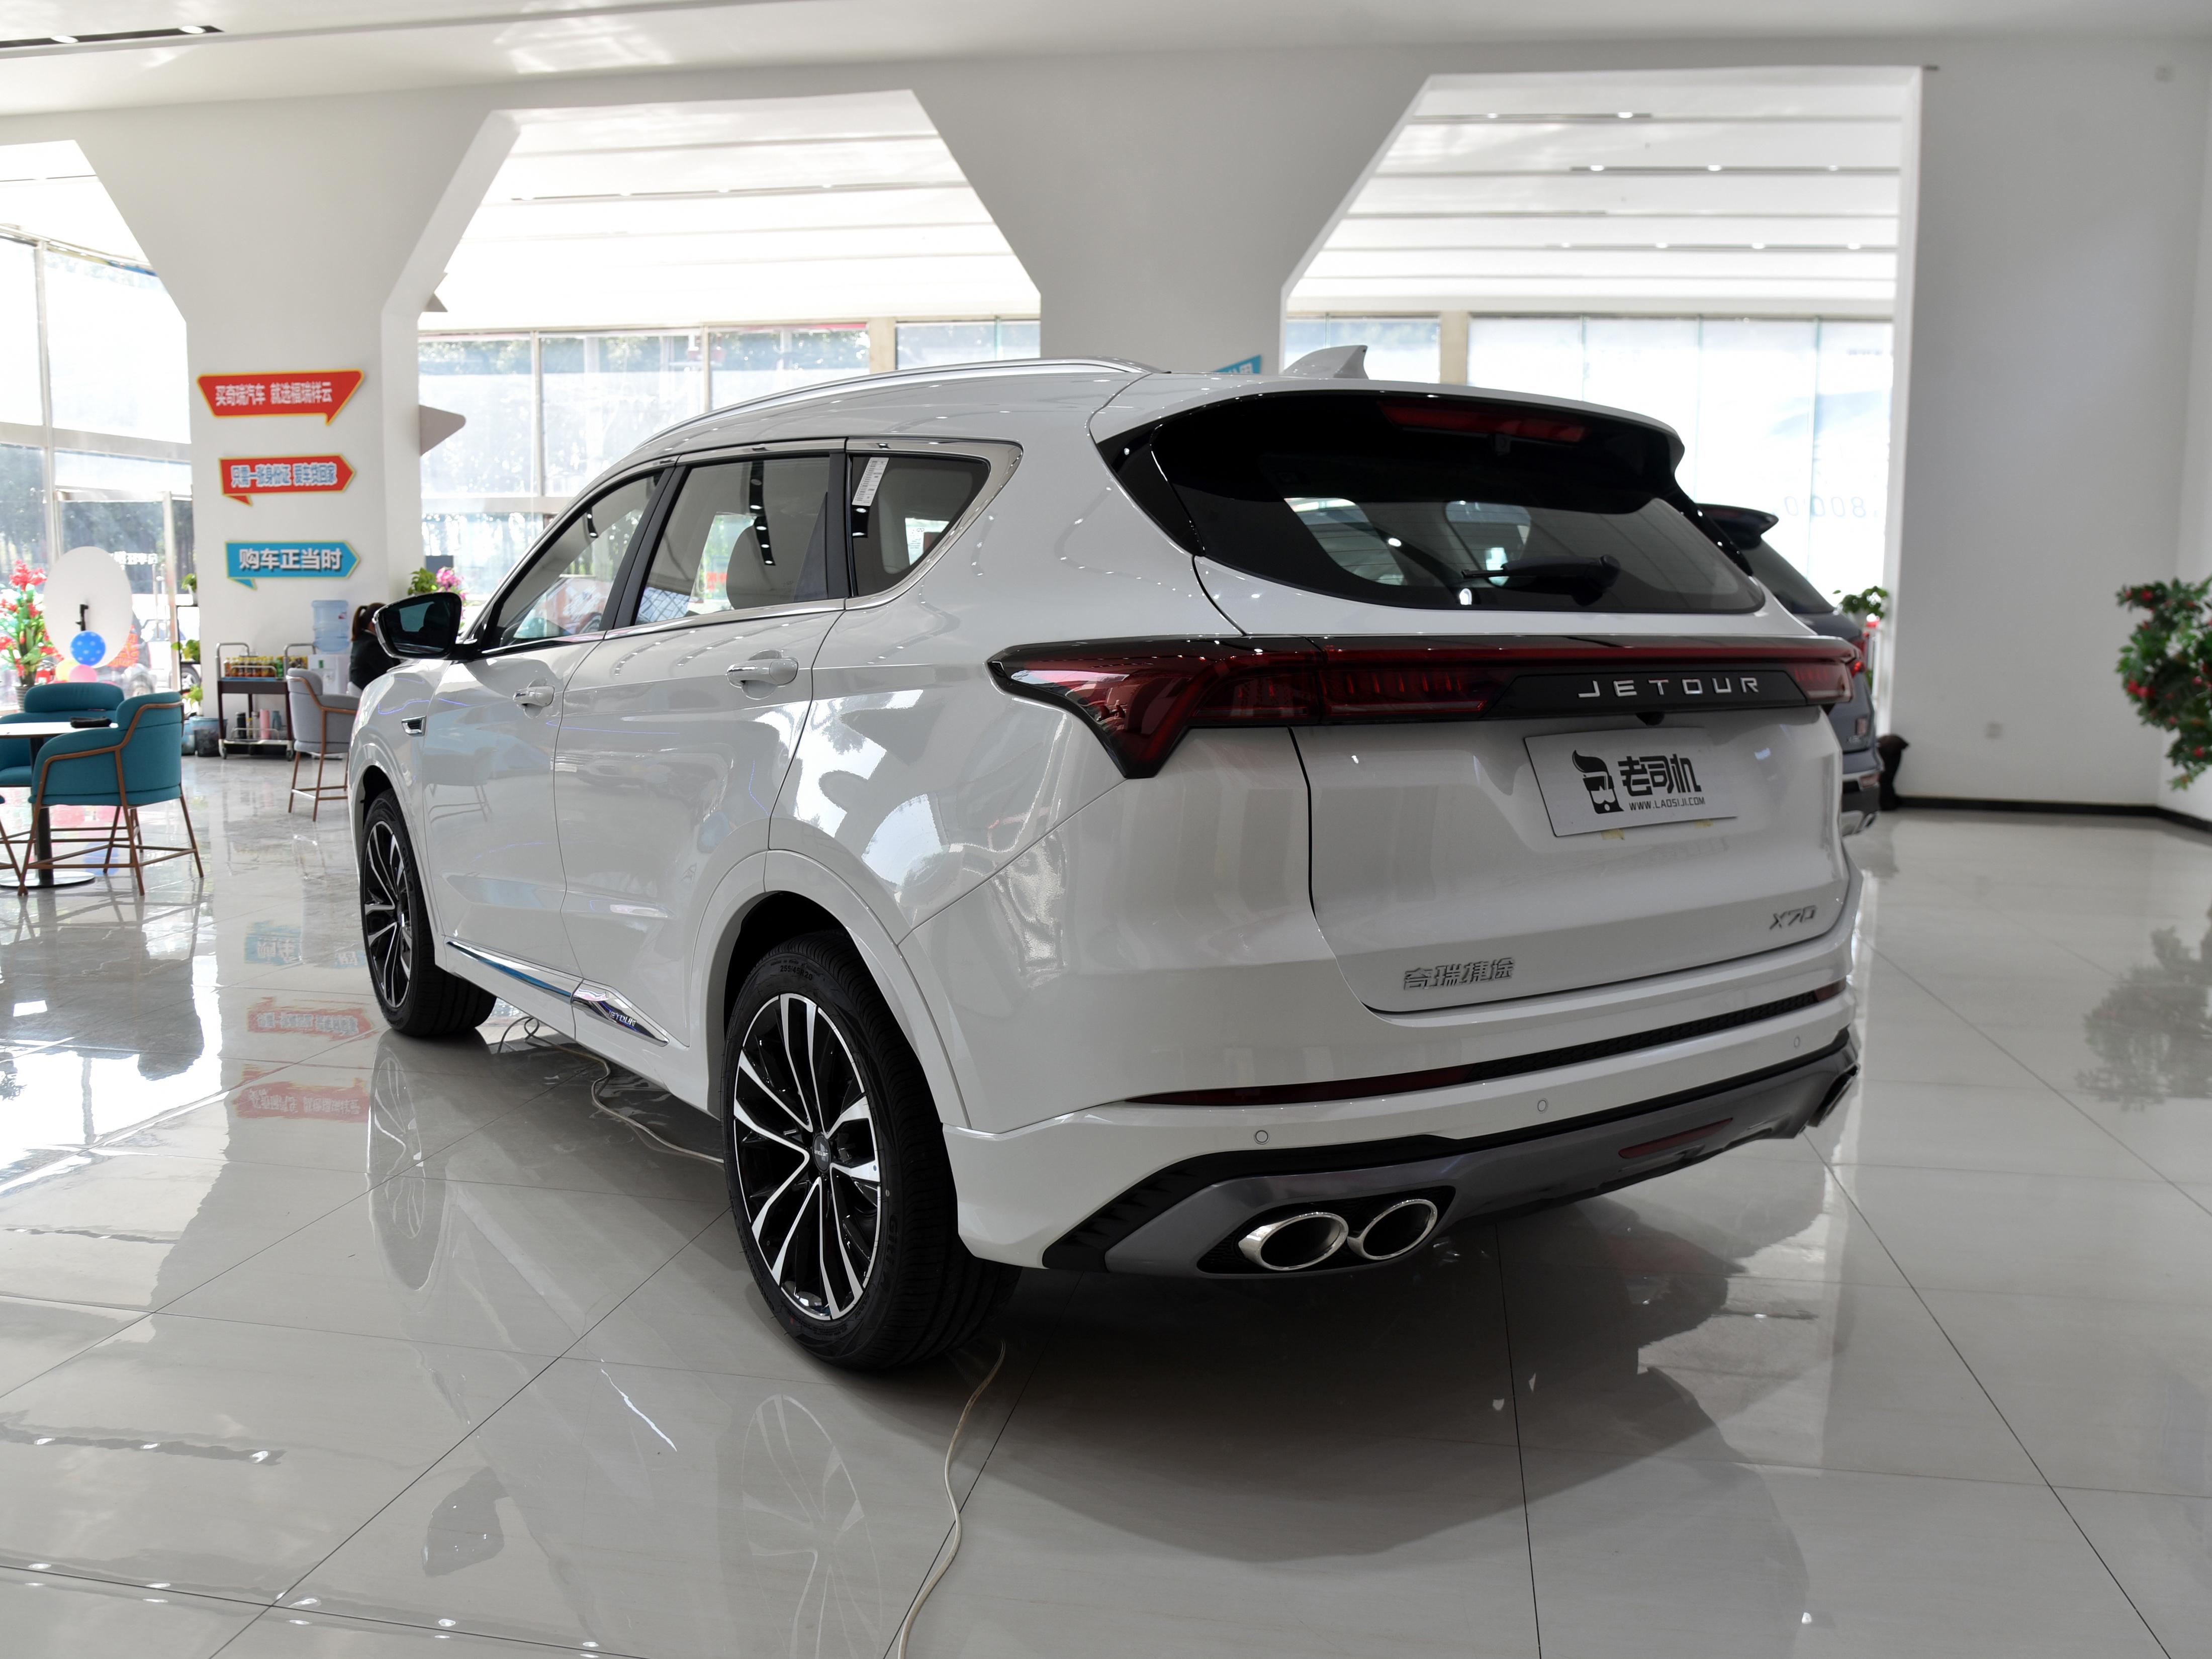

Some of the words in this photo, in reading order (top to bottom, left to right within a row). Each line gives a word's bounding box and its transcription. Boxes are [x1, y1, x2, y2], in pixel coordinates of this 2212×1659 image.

[215, 383, 265, 406] 买奇瑞汽车
[270, 381, 333, 404] 就选福瑞祥云
[231, 464, 292, 488] 只需一张身份证
[239, 548, 342, 570] 购车正当时
[1578, 677, 1759, 698] JETOUR
[1618, 754, 1702, 796] 老司机
[1629, 797, 1705, 811] WWW.LAOSIJI.COM
[1769, 905, 1818, 929] X70
[780, 965, 813, 981] 255/45R20
[1404, 957, 1514, 990] 奇瑞捷途
